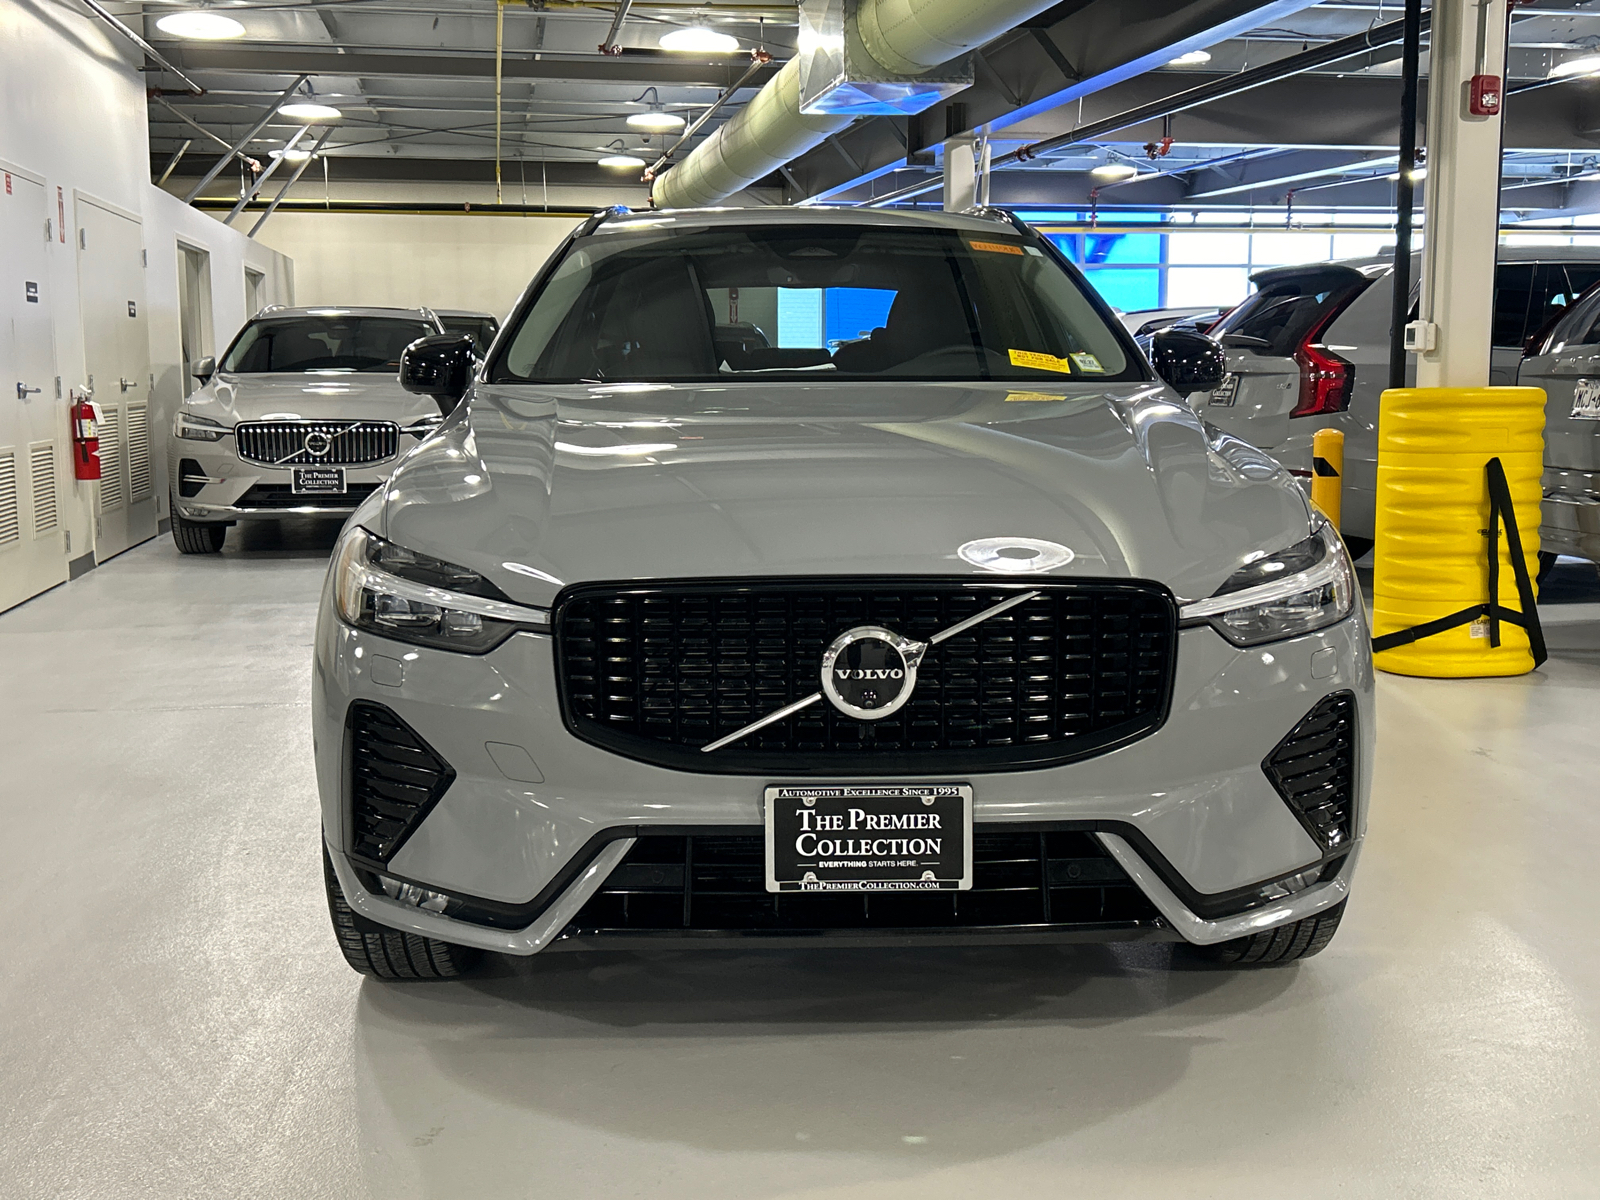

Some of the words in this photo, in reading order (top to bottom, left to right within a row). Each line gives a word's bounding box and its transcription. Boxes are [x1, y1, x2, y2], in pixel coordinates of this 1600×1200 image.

[835, 668, 904, 680] VOLVO
[781, 789, 841, 797] AUTOMOTIVE
[843, 788, 900, 796] EXCELLENCE
[902, 788, 930, 796] SINCE
[932, 787, 958, 796] 1995
[795, 808, 844, 831] THE
[847, 808, 942, 830] PREMIER
[795, 833, 942, 857] COLLECTION
[868, 860, 896, 868] STARTS
[799, 881, 940, 890] THEPREMIERCOLLECTION.COM
